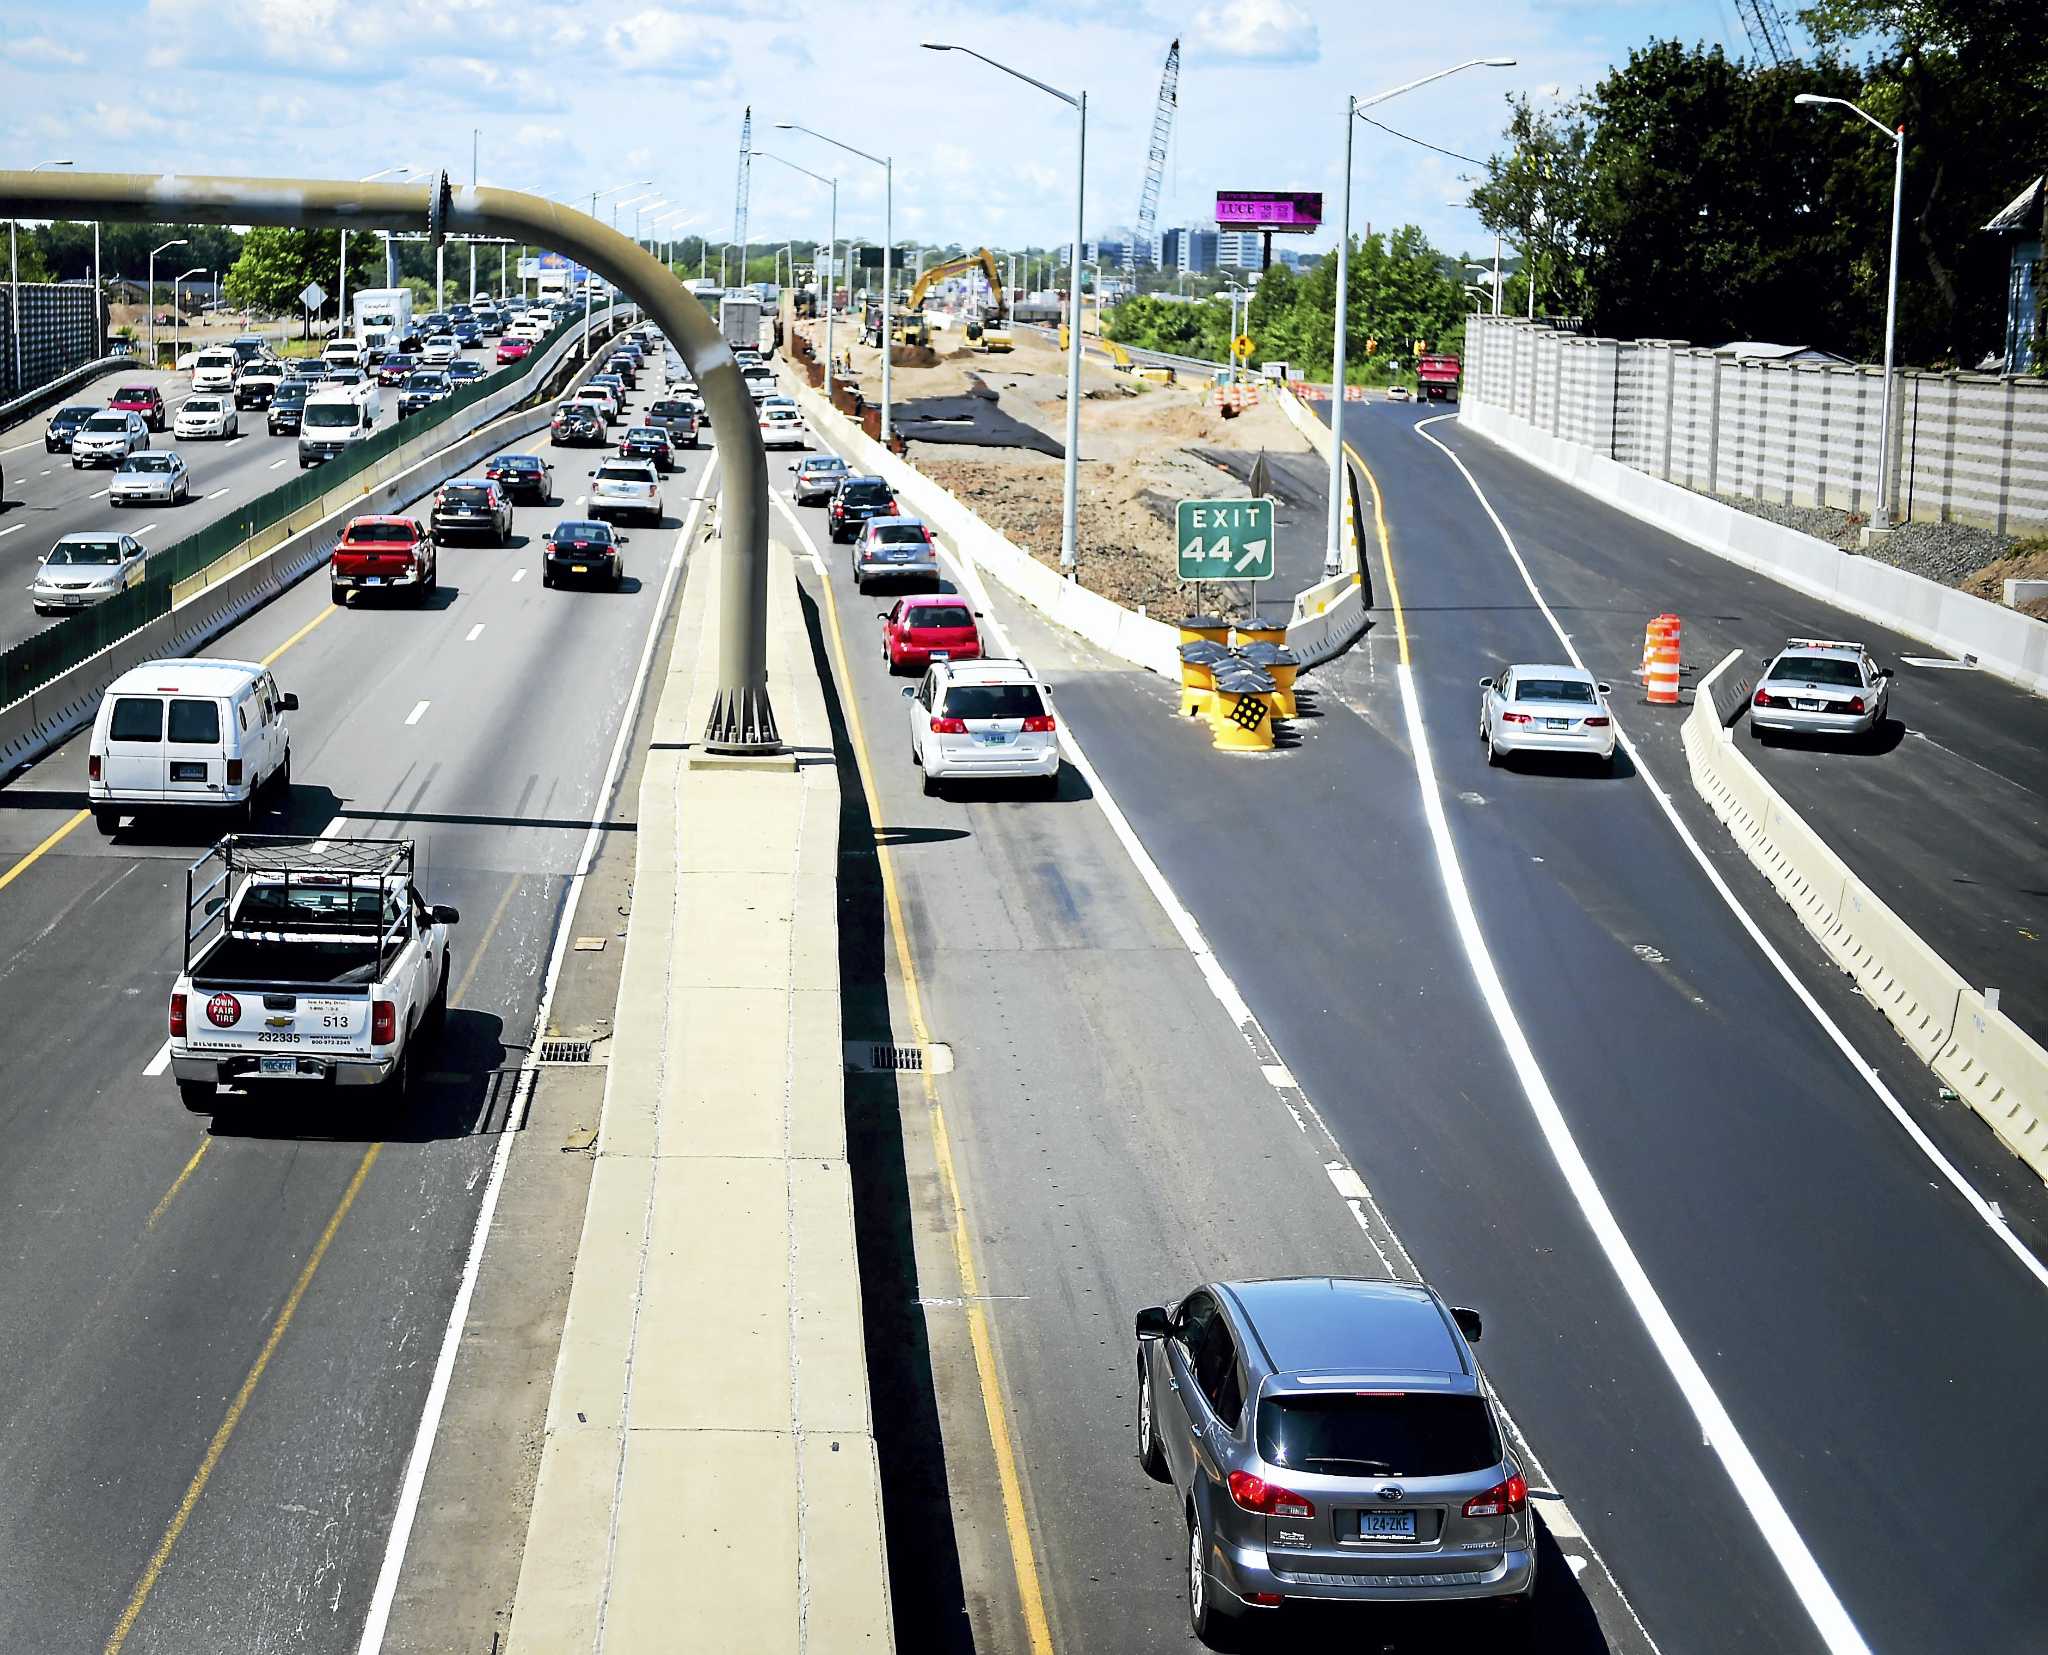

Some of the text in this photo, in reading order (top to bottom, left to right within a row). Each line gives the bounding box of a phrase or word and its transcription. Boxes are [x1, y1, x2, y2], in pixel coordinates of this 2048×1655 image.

[1221, 203, 1255, 214] LUCE
[1193, 508, 1260, 528] EXIT
[1182, 535, 1233, 562] 44
[210, 998, 233, 1007] TOWN
[213, 1006, 234, 1014] FAIR
[216, 1014, 234, 1023] TIRE
[323, 1016, 348, 1028] 513
[258, 1032, 301, 1043] 232335
